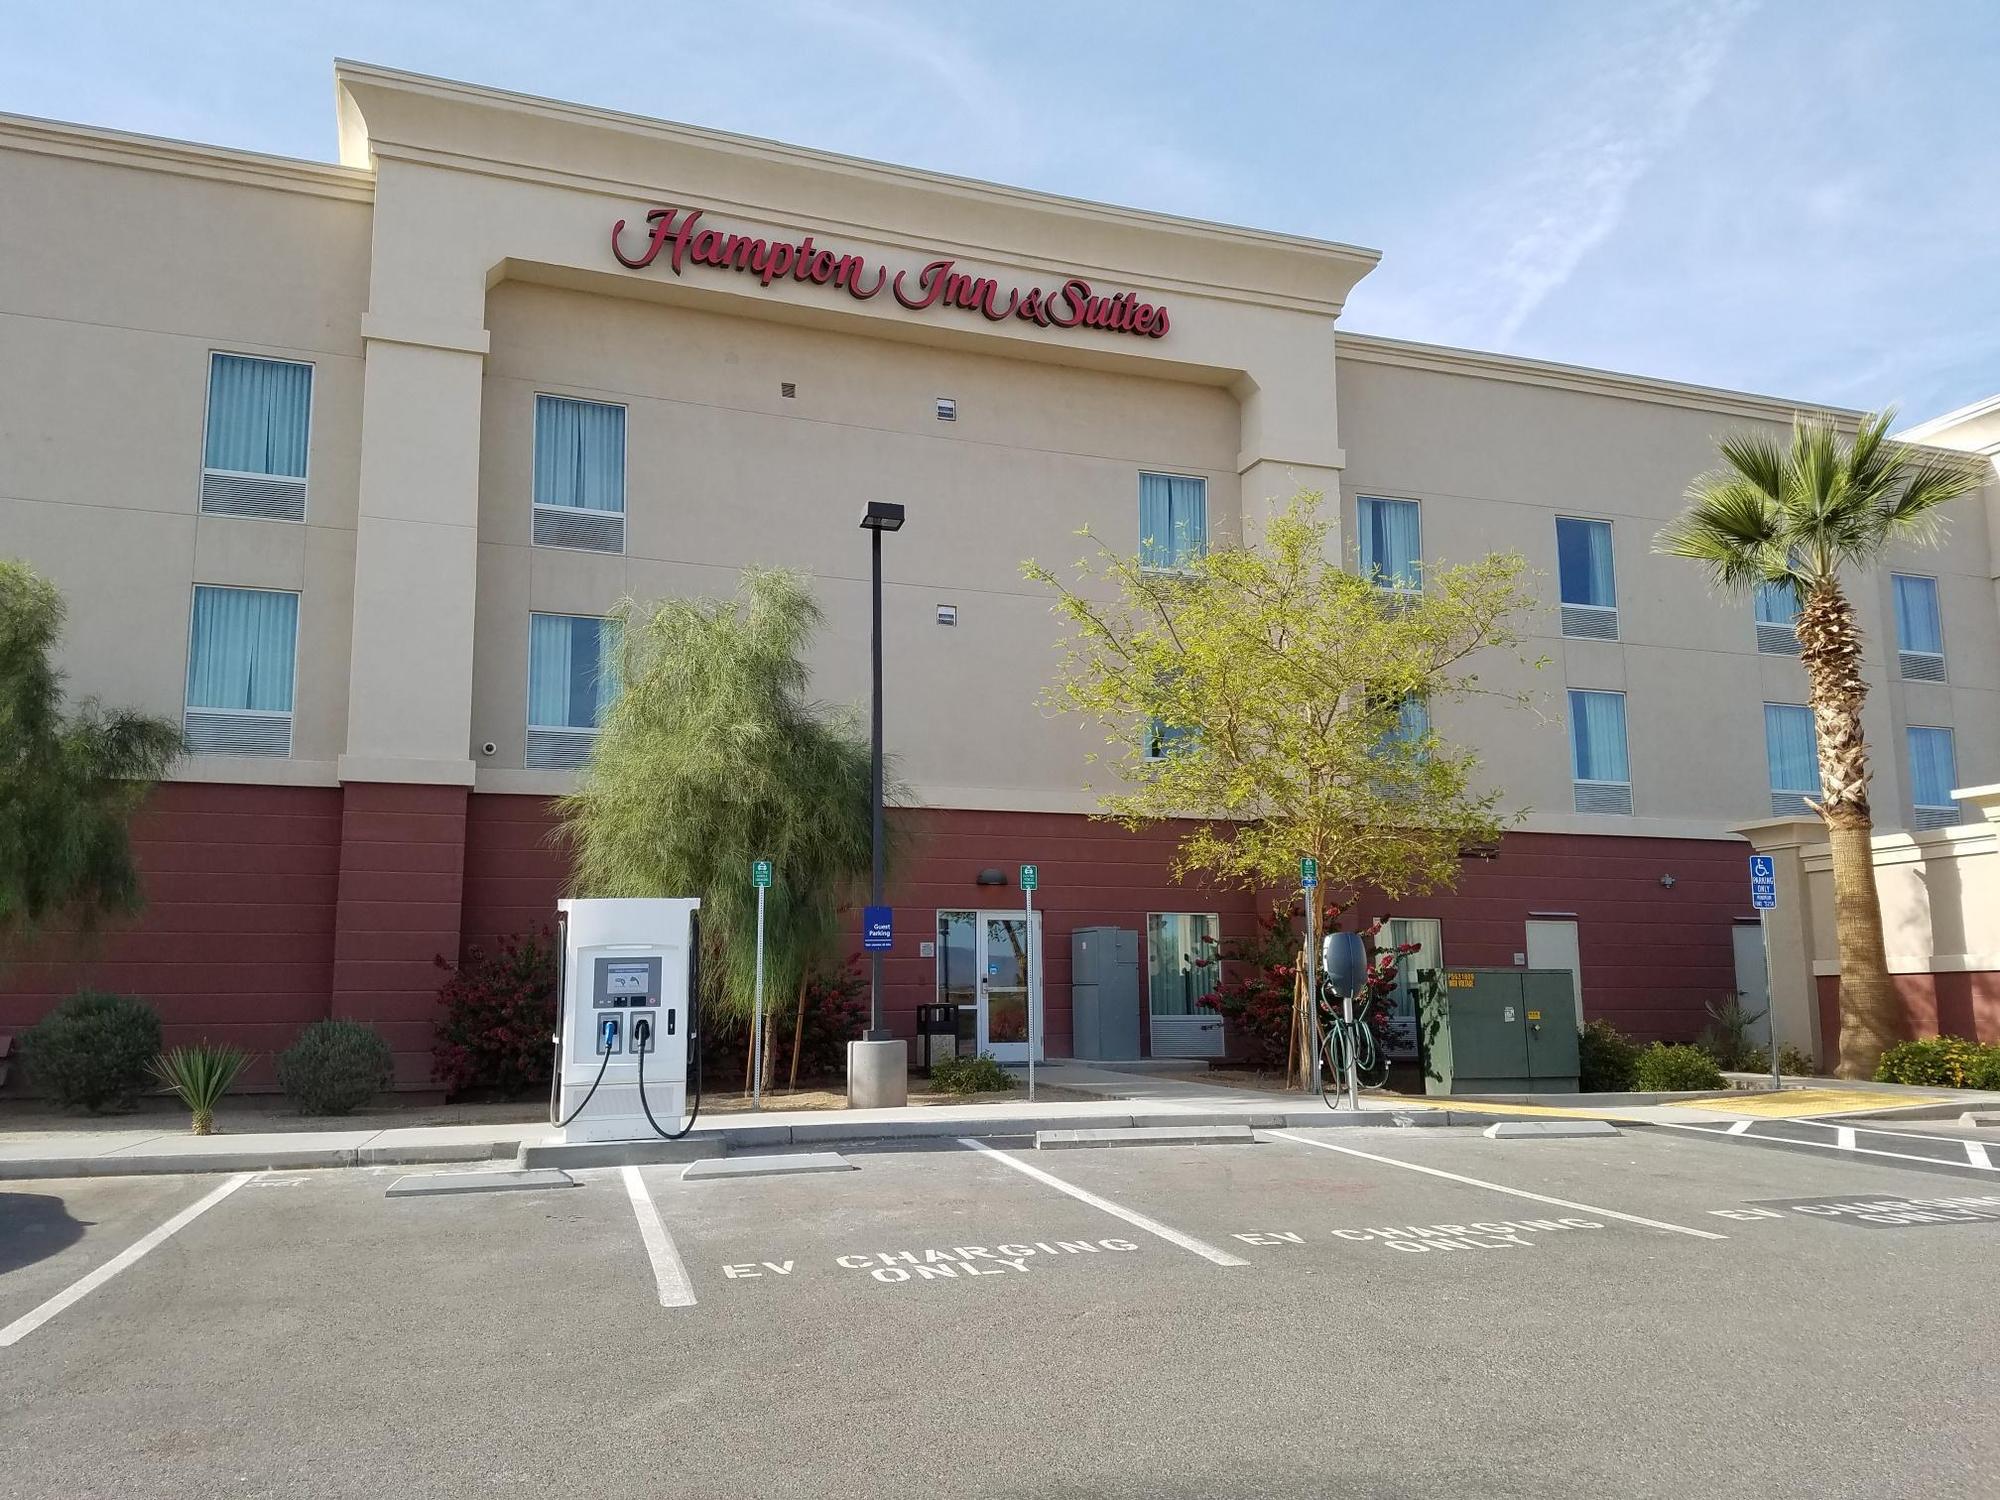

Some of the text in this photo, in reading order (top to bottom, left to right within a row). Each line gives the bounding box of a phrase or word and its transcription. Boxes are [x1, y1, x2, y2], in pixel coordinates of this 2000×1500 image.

[611, 208, 1172, 339] Hampton Inn & Suites
[1753, 876, 1774, 885] PARKING
[1757, 885, 1770, 893] ONLY
[869, 930, 891, 938] Parking
[1231, 1217, 1606, 1246] EV CHARGING
[1384, 1234, 1536, 1253] ONLY
[722, 1237, 1140, 1279] EV CHARGING
[870, 1256, 1033, 1284] ONLY
